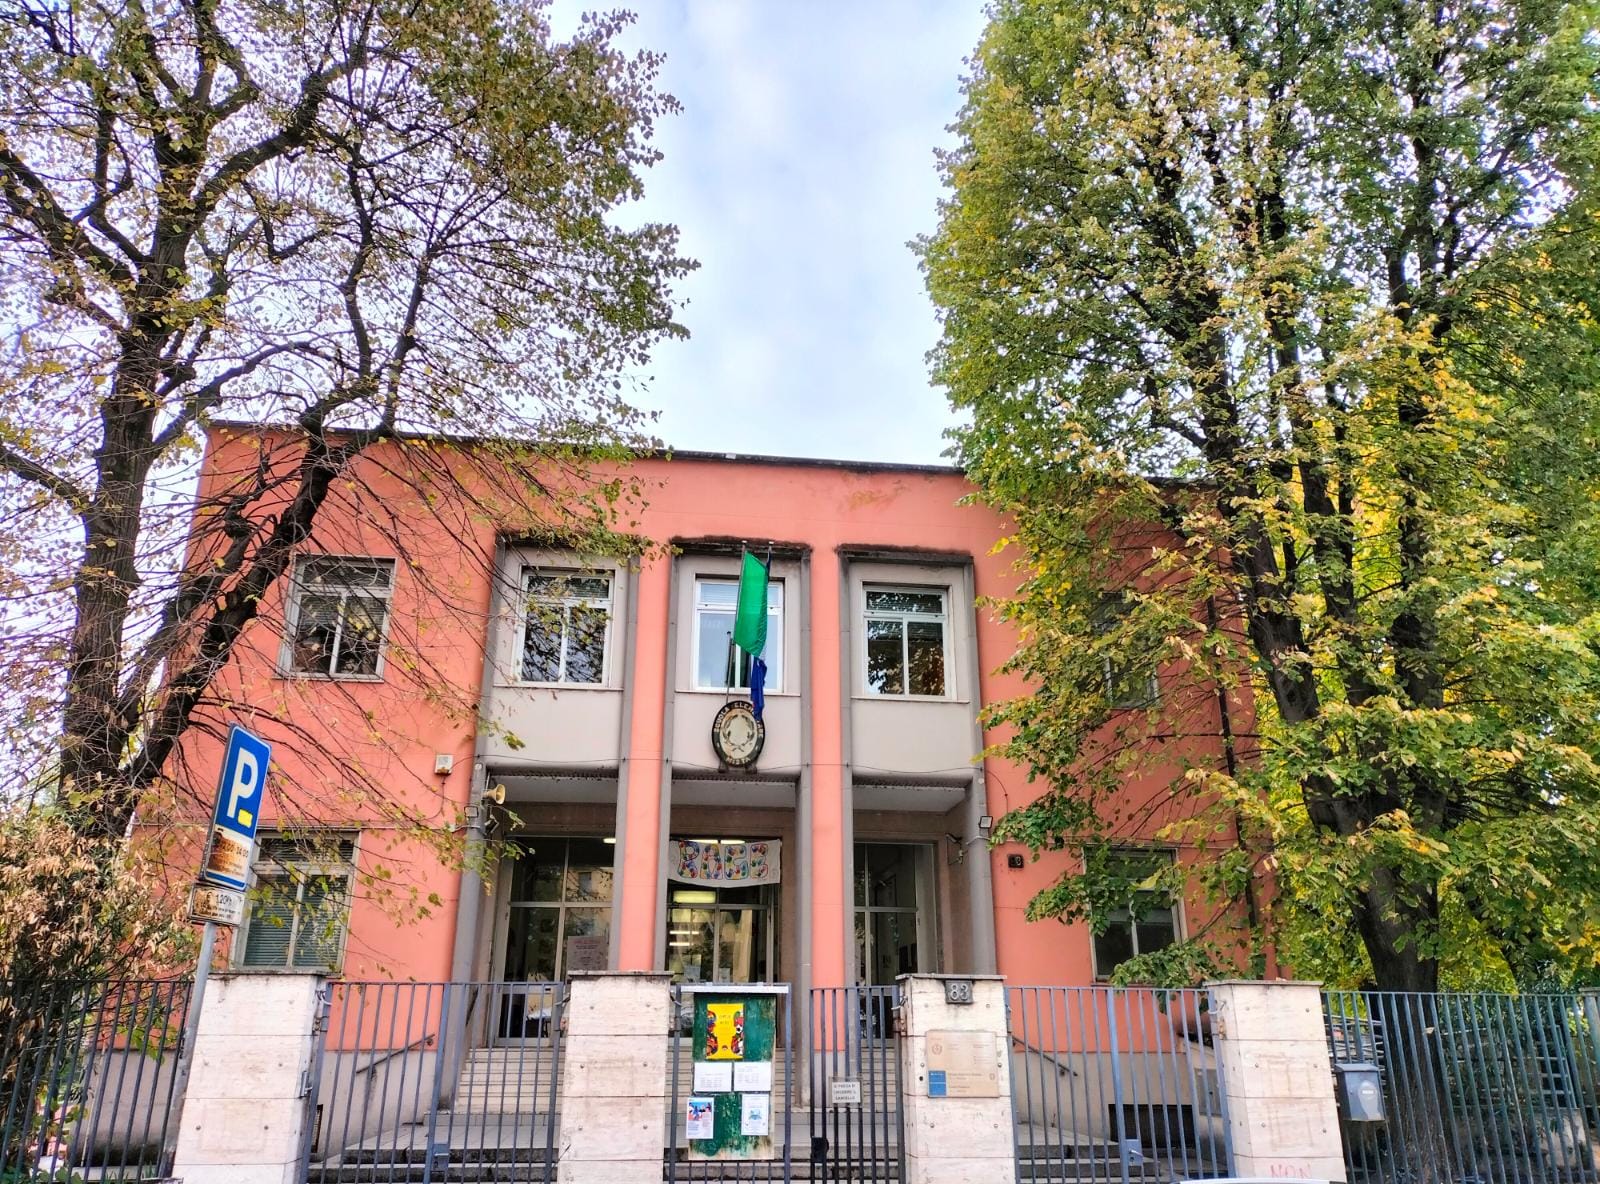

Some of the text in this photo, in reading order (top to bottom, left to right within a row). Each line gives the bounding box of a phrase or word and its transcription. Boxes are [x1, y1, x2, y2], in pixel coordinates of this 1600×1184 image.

[714, 706, 730, 733] SCUOLA
[726, 756, 751, 765] MISTA
[227, 747, 258, 819] P
[950, 983, 969, 1001] 83
